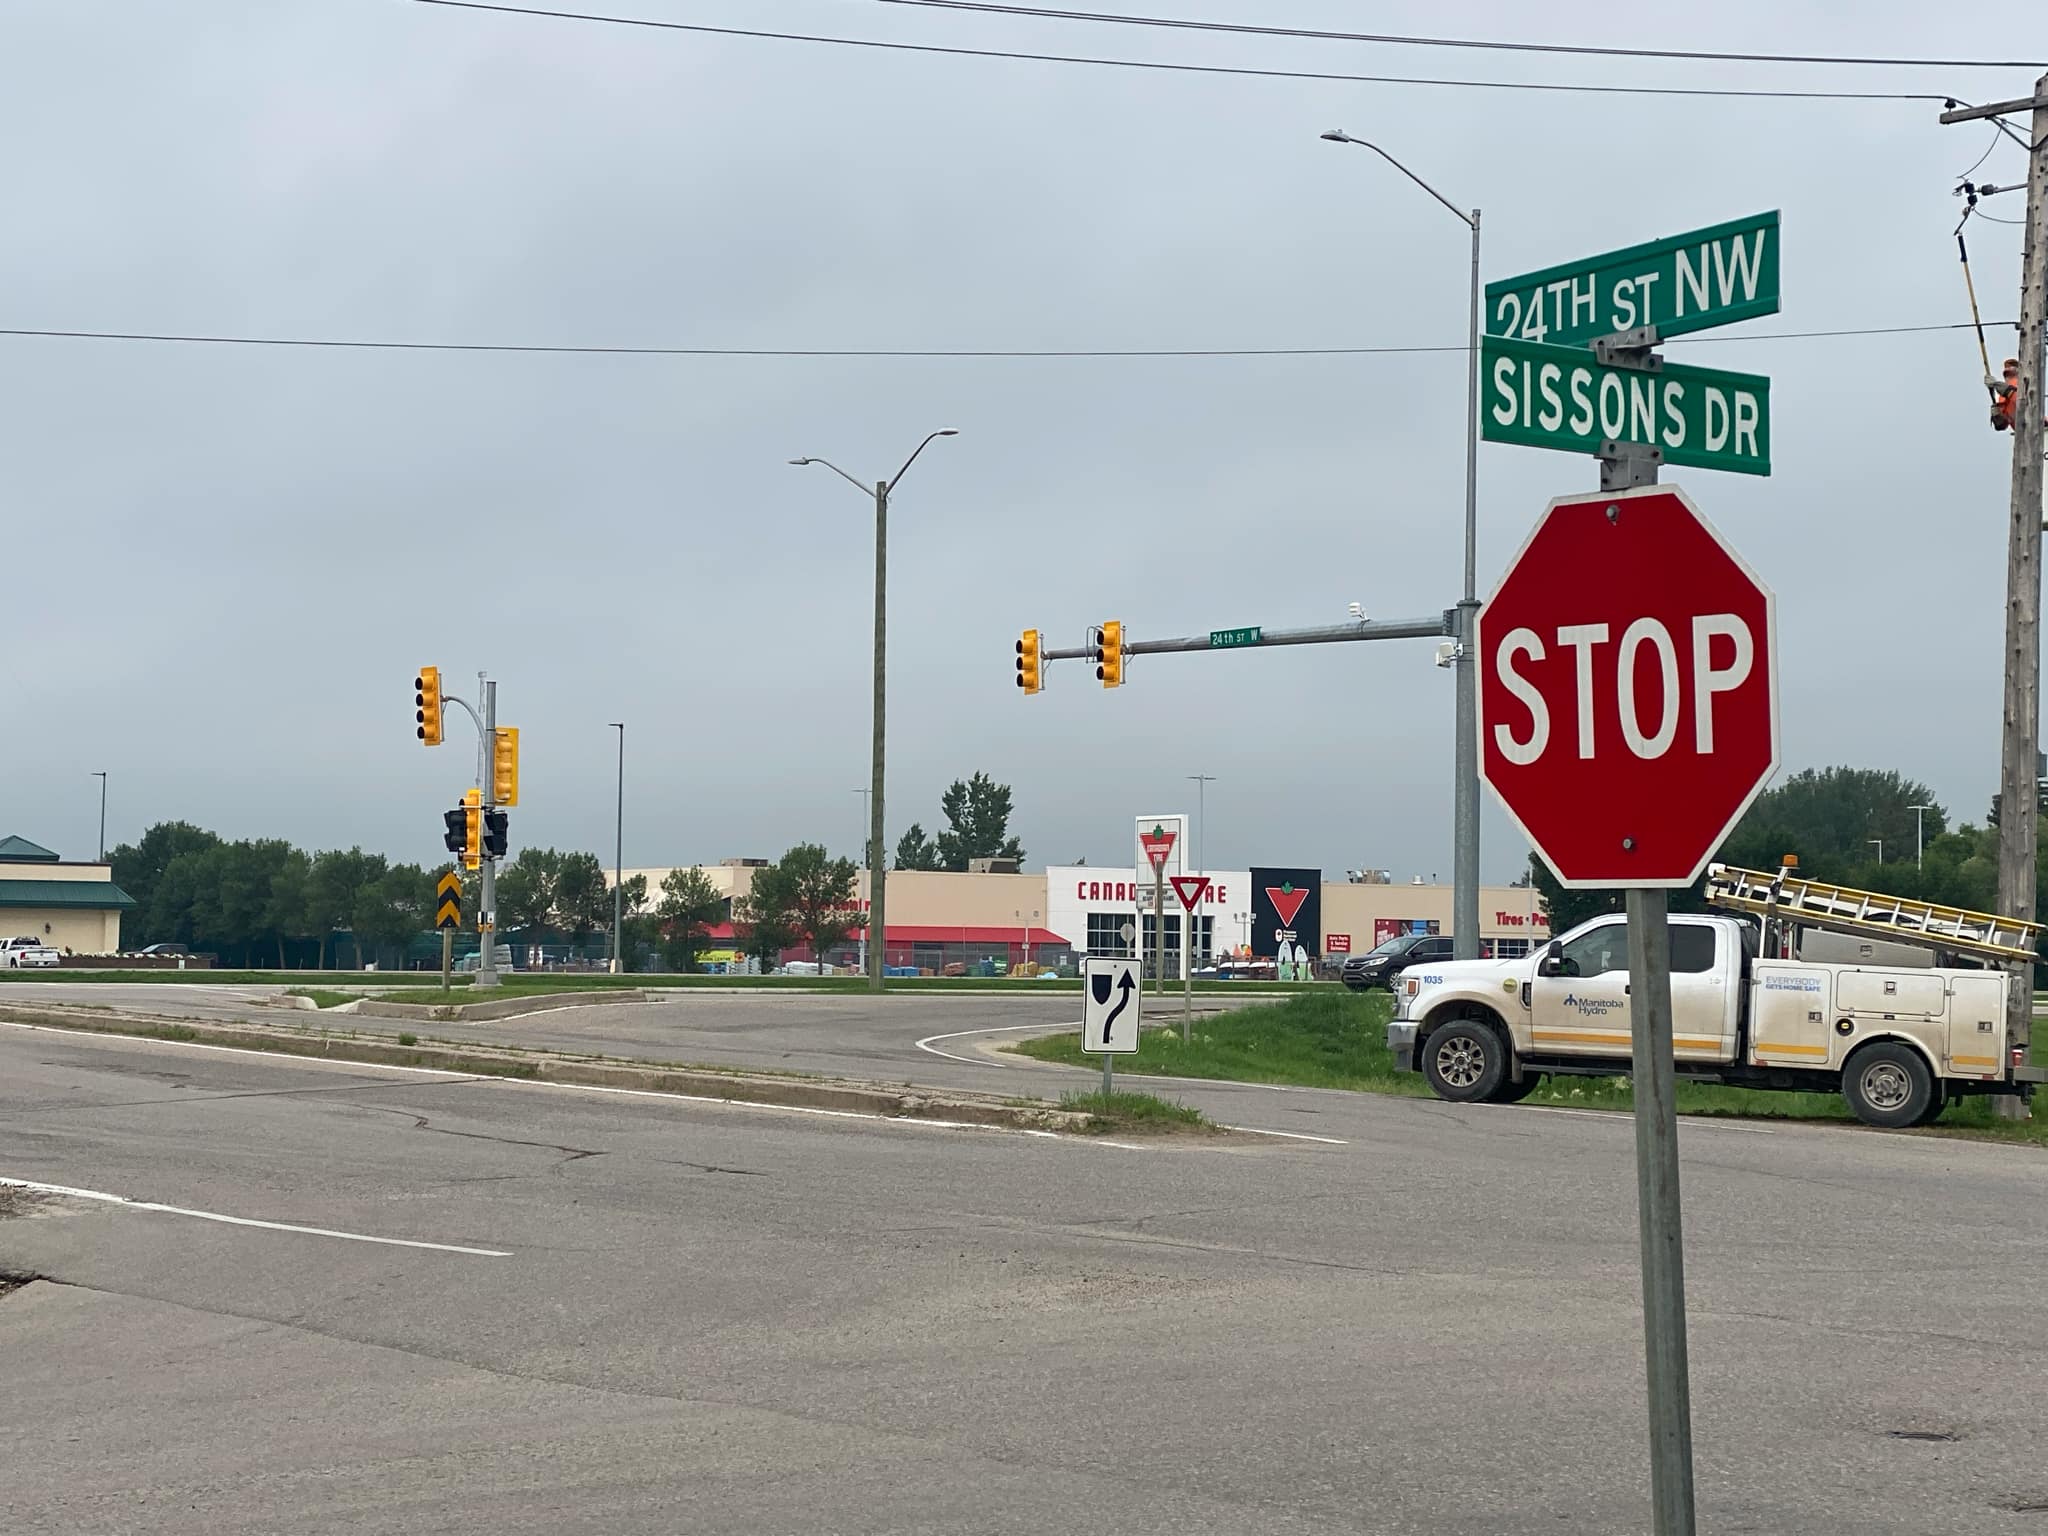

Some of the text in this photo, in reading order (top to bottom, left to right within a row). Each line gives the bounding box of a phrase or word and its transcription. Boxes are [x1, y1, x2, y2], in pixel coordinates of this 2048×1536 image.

[1496, 229, 1766, 343] 24TH ST NW
[1492, 356, 1760, 457] SISSONS DR
[1212, 631, 1234, 646] 24th
[1250, 628, 1258, 641] W
[1494, 613, 1754, 766] STOP
[1077, 881, 1136, 902] CANAD
[1496, 911, 1524, 927] Tires
[1424, 975, 1443, 985] 1035
[1766, 975, 1822, 986] EVERYBODY
[1579, 998, 1624, 1009] Manitoba
[1579, 1006, 1608, 1016] Hydro
